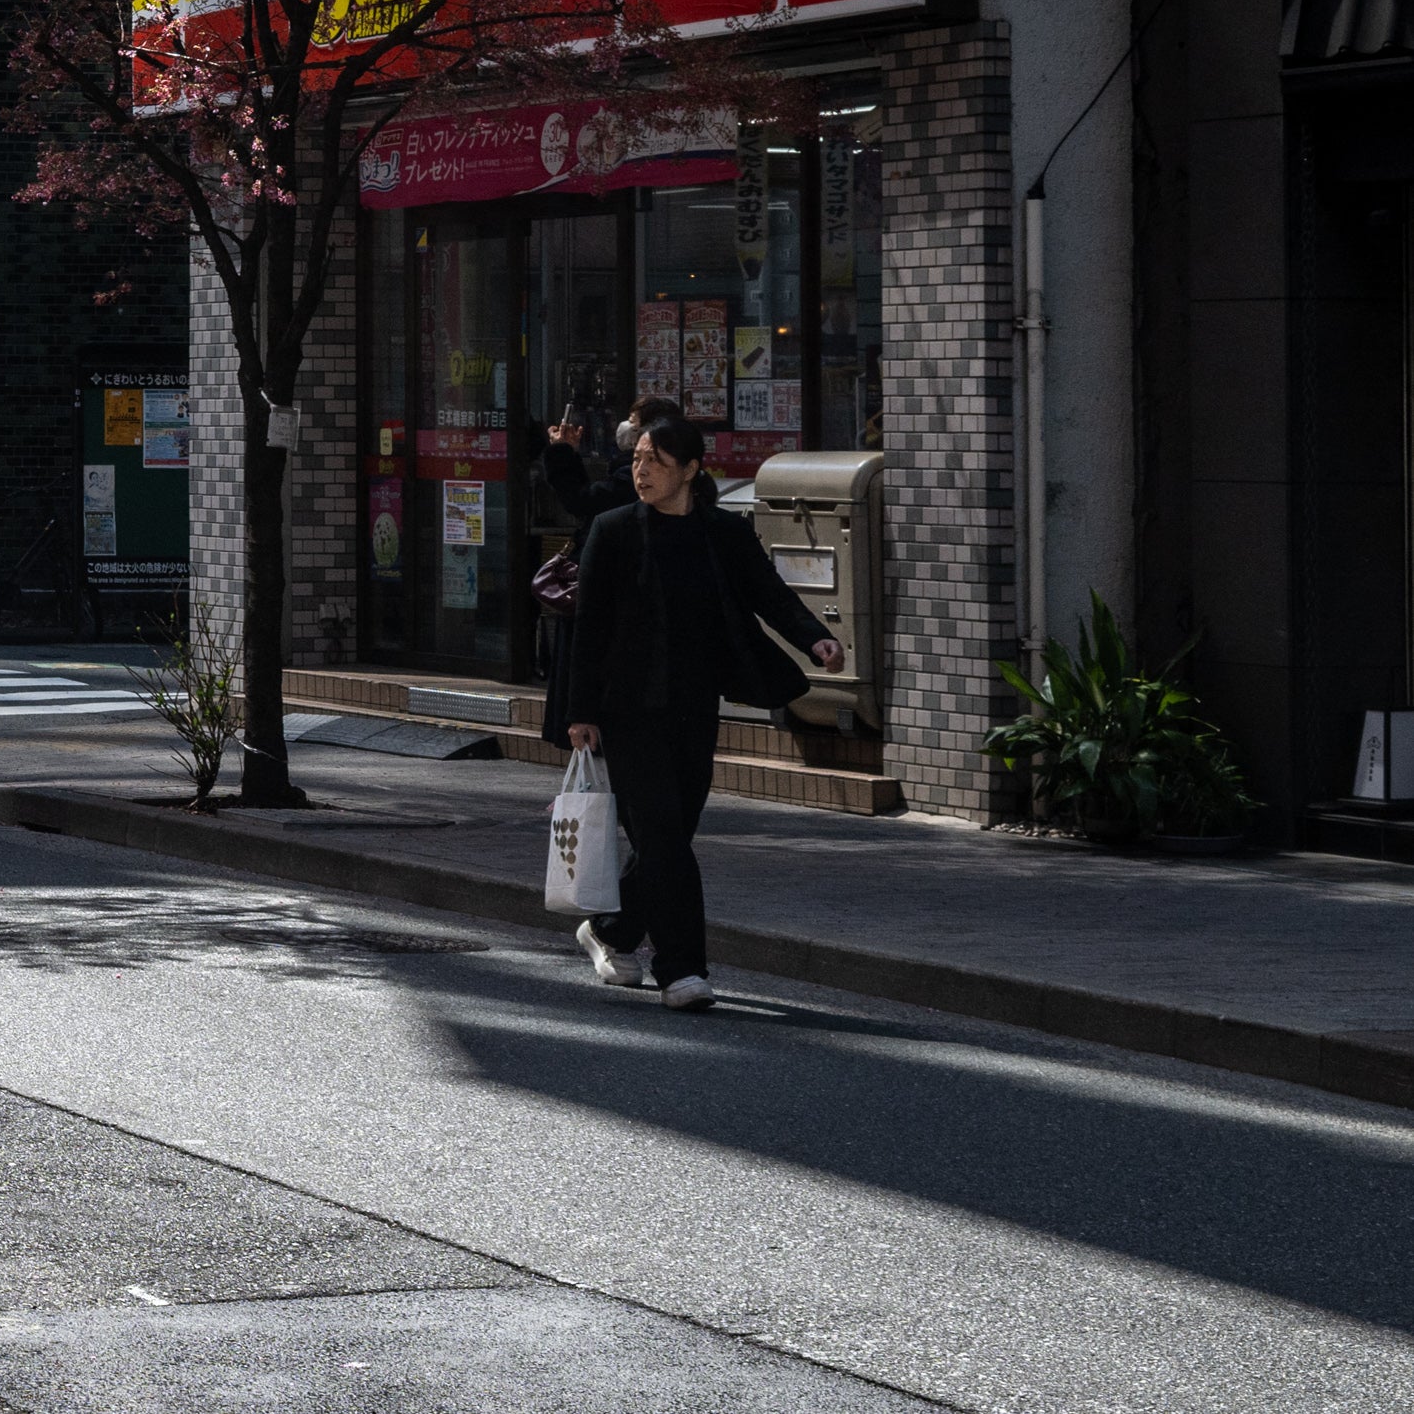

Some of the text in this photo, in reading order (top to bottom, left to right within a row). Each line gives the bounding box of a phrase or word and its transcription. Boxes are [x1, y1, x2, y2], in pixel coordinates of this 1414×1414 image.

[104, 373, 190, 386] にぎわいとうるおいの
